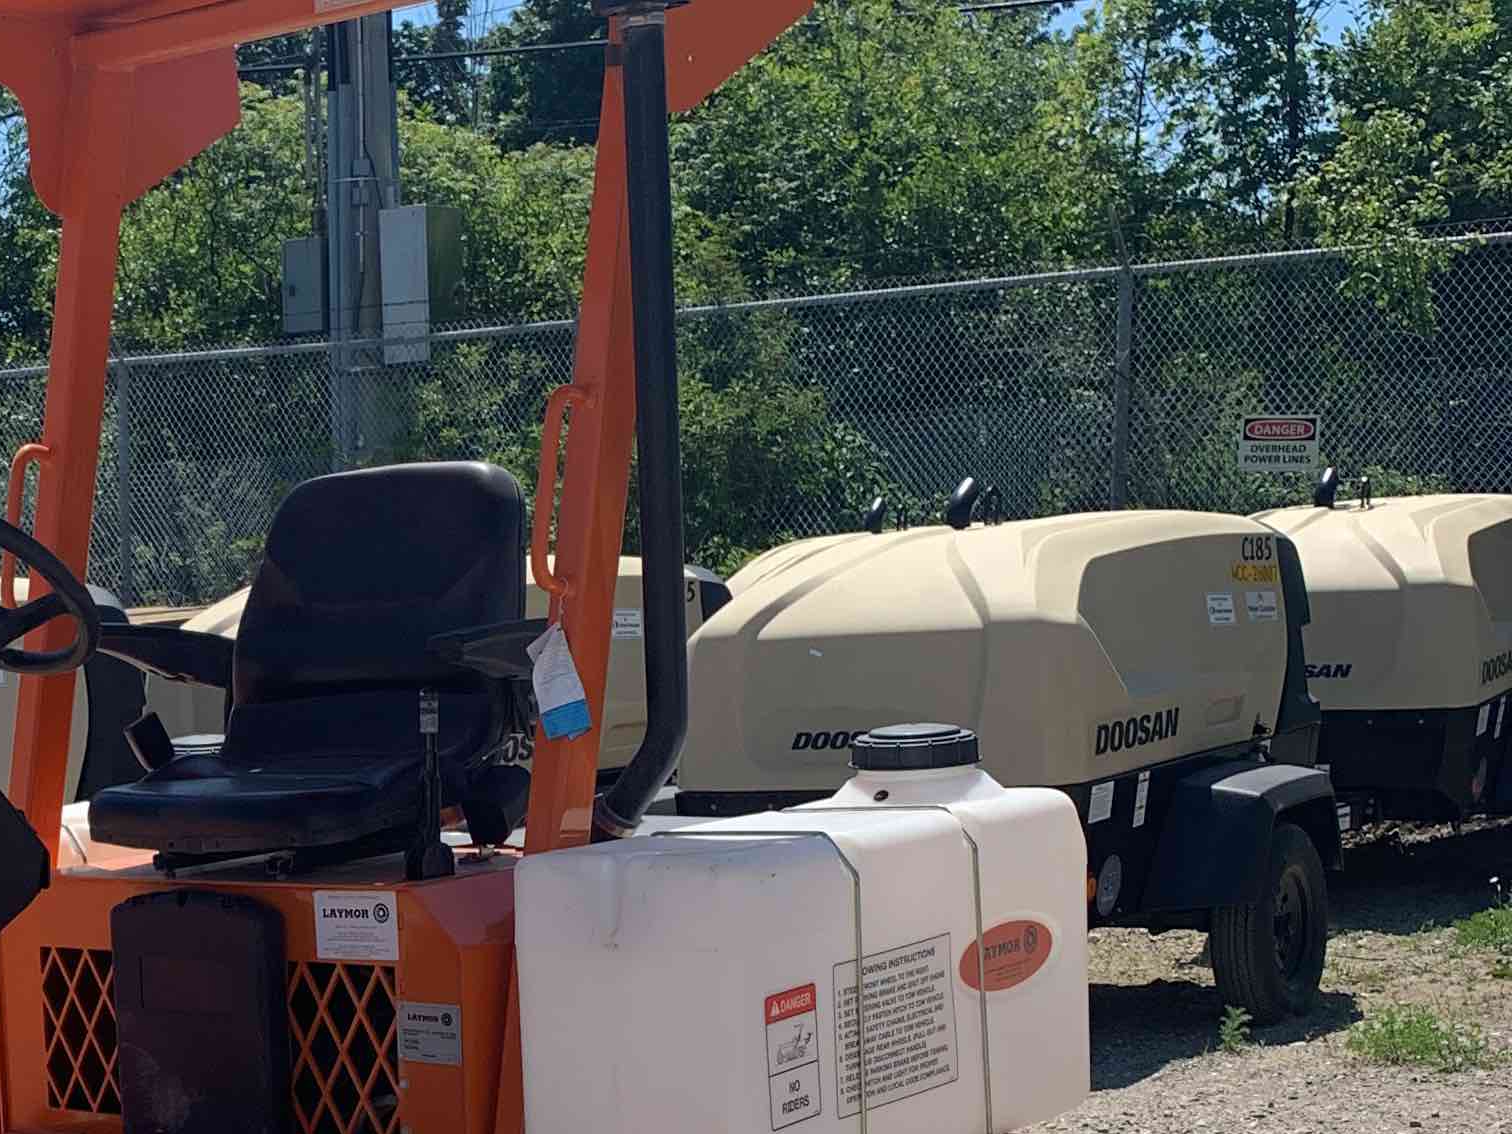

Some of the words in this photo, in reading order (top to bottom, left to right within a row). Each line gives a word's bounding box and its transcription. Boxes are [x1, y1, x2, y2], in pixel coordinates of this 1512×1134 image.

[1254, 424, 1305, 435] DANGER
[1250, 444, 1306, 453] OVERHEAD
[1244, 455, 1282, 464] POWER
[1283, 455, 1311, 464] LINES
[1241, 535, 1272, 560] C185
[1095, 707, 1179, 756] DOOSAN
[983, 937, 1022, 961] AYMOR
[861, 960, 886, 976] OWING
[888, 947, 935, 968] INSTRUCTIONS
[780, 992, 811, 1013] DANGER
[789, 1079, 801, 1093] NO
[781, 1094, 810, 1115] RIDERS
